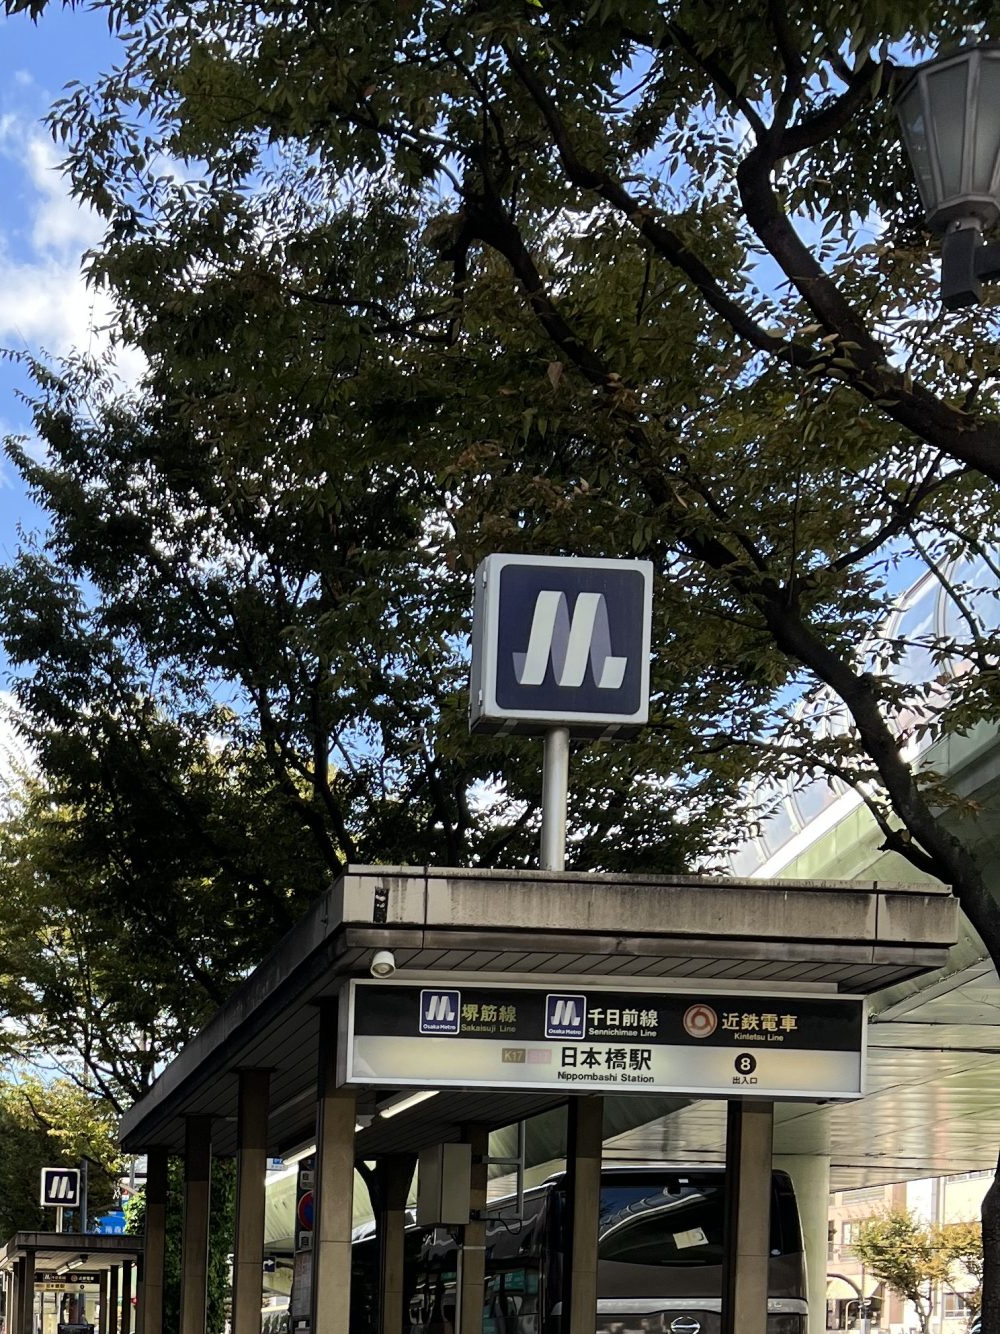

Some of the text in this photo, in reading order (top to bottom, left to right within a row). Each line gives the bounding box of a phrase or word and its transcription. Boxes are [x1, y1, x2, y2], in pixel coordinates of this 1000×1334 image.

[462, 1004, 516, 1022] 堺筋線
[588, 1008, 658, 1027] 千日前線
[721, 1012, 798, 1032] 近鉄電車
[461, 1024, 496, 1033] Sakaisuji
[589, 1027, 657, 1037] Sennichimae Line
[734, 1032, 765, 1040] Kintetsu
[504, 1050, 522, 1061] K17
[561, 1047, 652, 1070] 日本橋駅
[740, 1057, 751, 1070] 8
[558, 1072, 655, 1082] Nippombashi Station
[732, 1076, 758, 1084] 出入口
